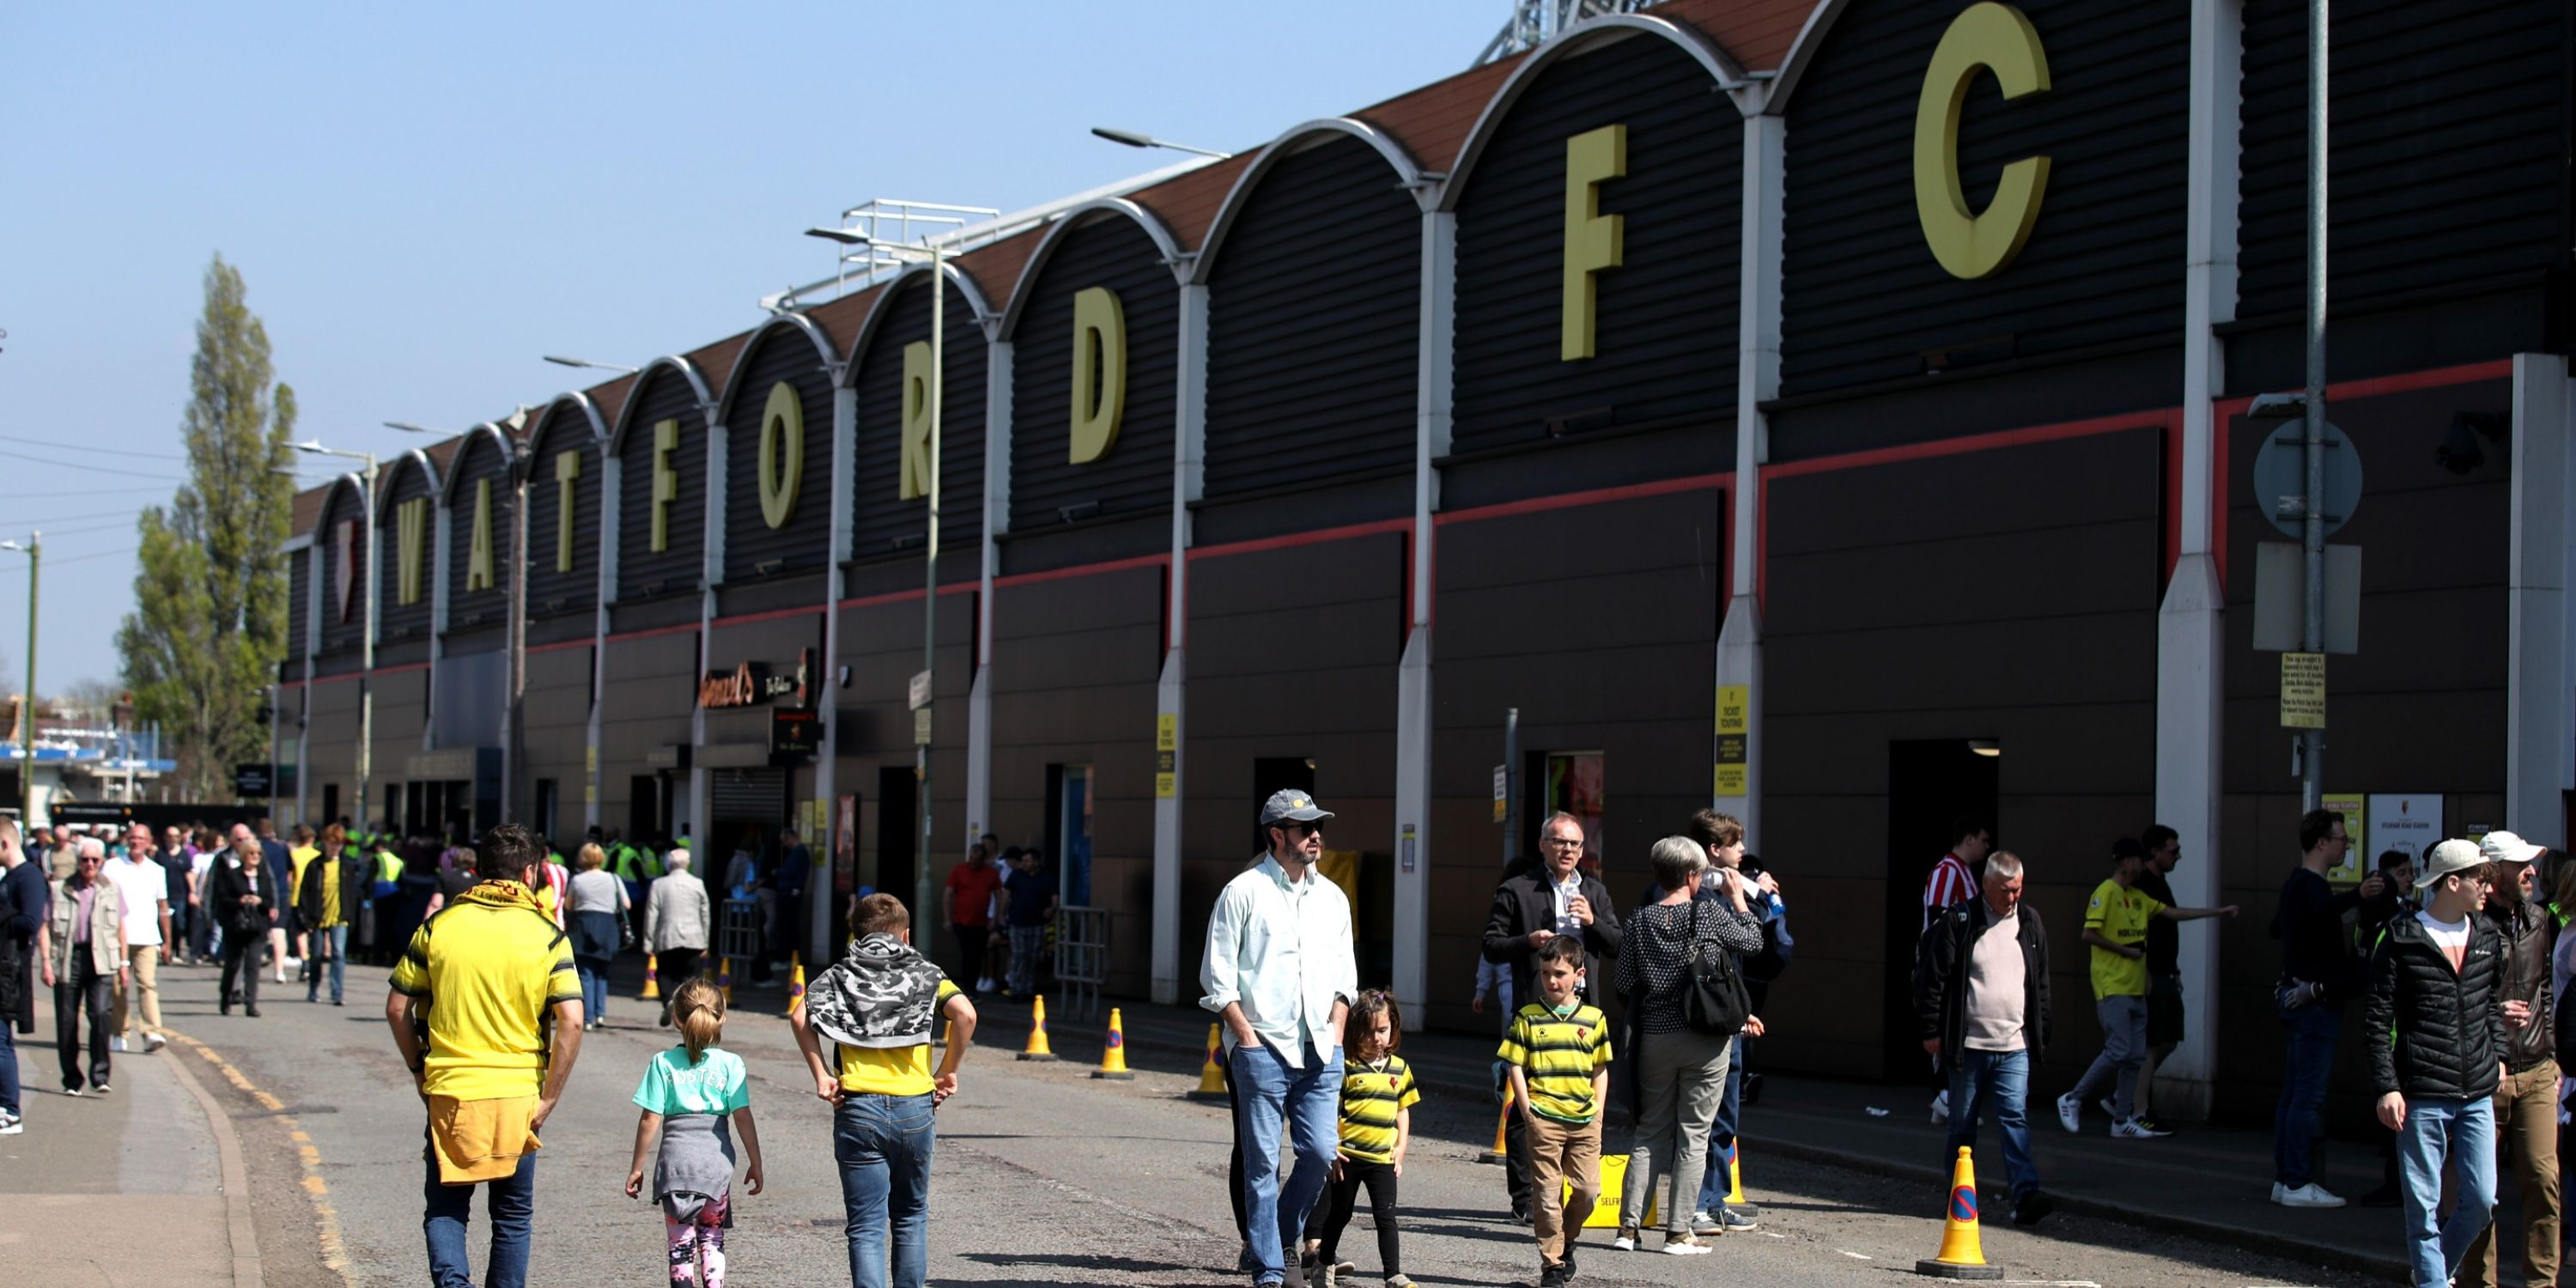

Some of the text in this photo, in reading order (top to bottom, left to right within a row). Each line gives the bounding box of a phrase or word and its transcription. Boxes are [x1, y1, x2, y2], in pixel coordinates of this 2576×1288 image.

[398, 2, 2051, 605] WATFORD FC
[1723, 706, 1741, 716] TICKET
[1721, 718, 1742, 728] TOUTING
